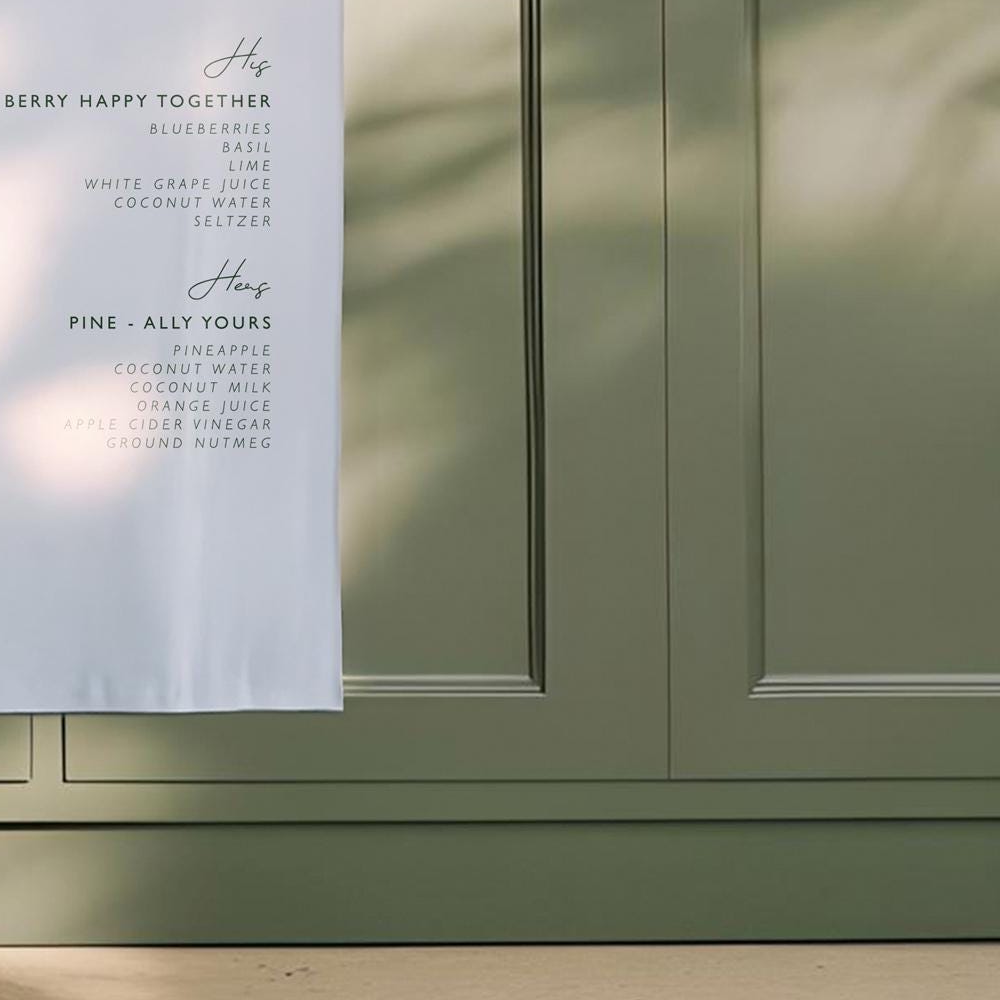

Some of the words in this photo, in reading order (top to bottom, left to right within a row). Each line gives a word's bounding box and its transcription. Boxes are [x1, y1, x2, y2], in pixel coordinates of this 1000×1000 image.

[203, 36, 272, 79] His
[4, 93, 68, 109] BERRY
[79, 93, 147, 109] HAPPY
[157, 93, 271, 109] TOGETHER
[149, 122, 271, 136] BLUEBERRIES
[222, 141, 271, 154] BASIL
[228, 159, 271, 172] LIME
[85, 178, 142, 191] WHITE
[153, 178, 211, 191] GRAPE
[220, 178, 271, 194] JUICE
[114, 196, 202, 209] COCONUT
[212, 196, 271, 209] WATER
[193, 215, 271, 228] SELTZER
[69, 315, 117, 330] PINE
[143, 315, 193, 330] ALLY
[202, 315, 272, 330] YOURS
[173, 344, 271, 357] PINEAPPLE
[114, 362, 202, 375] COCONUT
[211, 362, 271, 375] WATER
[130, 381, 218, 394] COCONUT
[228, 381, 271, 394] MILK
[137, 400, 210, 412] ORANGE
[219, 400, 271, 415] JUICE
[64, 418, 117, 431] APPLE
[129, 418, 183, 431] CIDER
[193, 418, 271, 431] VINEGAR
[106, 436, 183, 449] GROUND
[194, 436, 272, 449] NUTMEG
